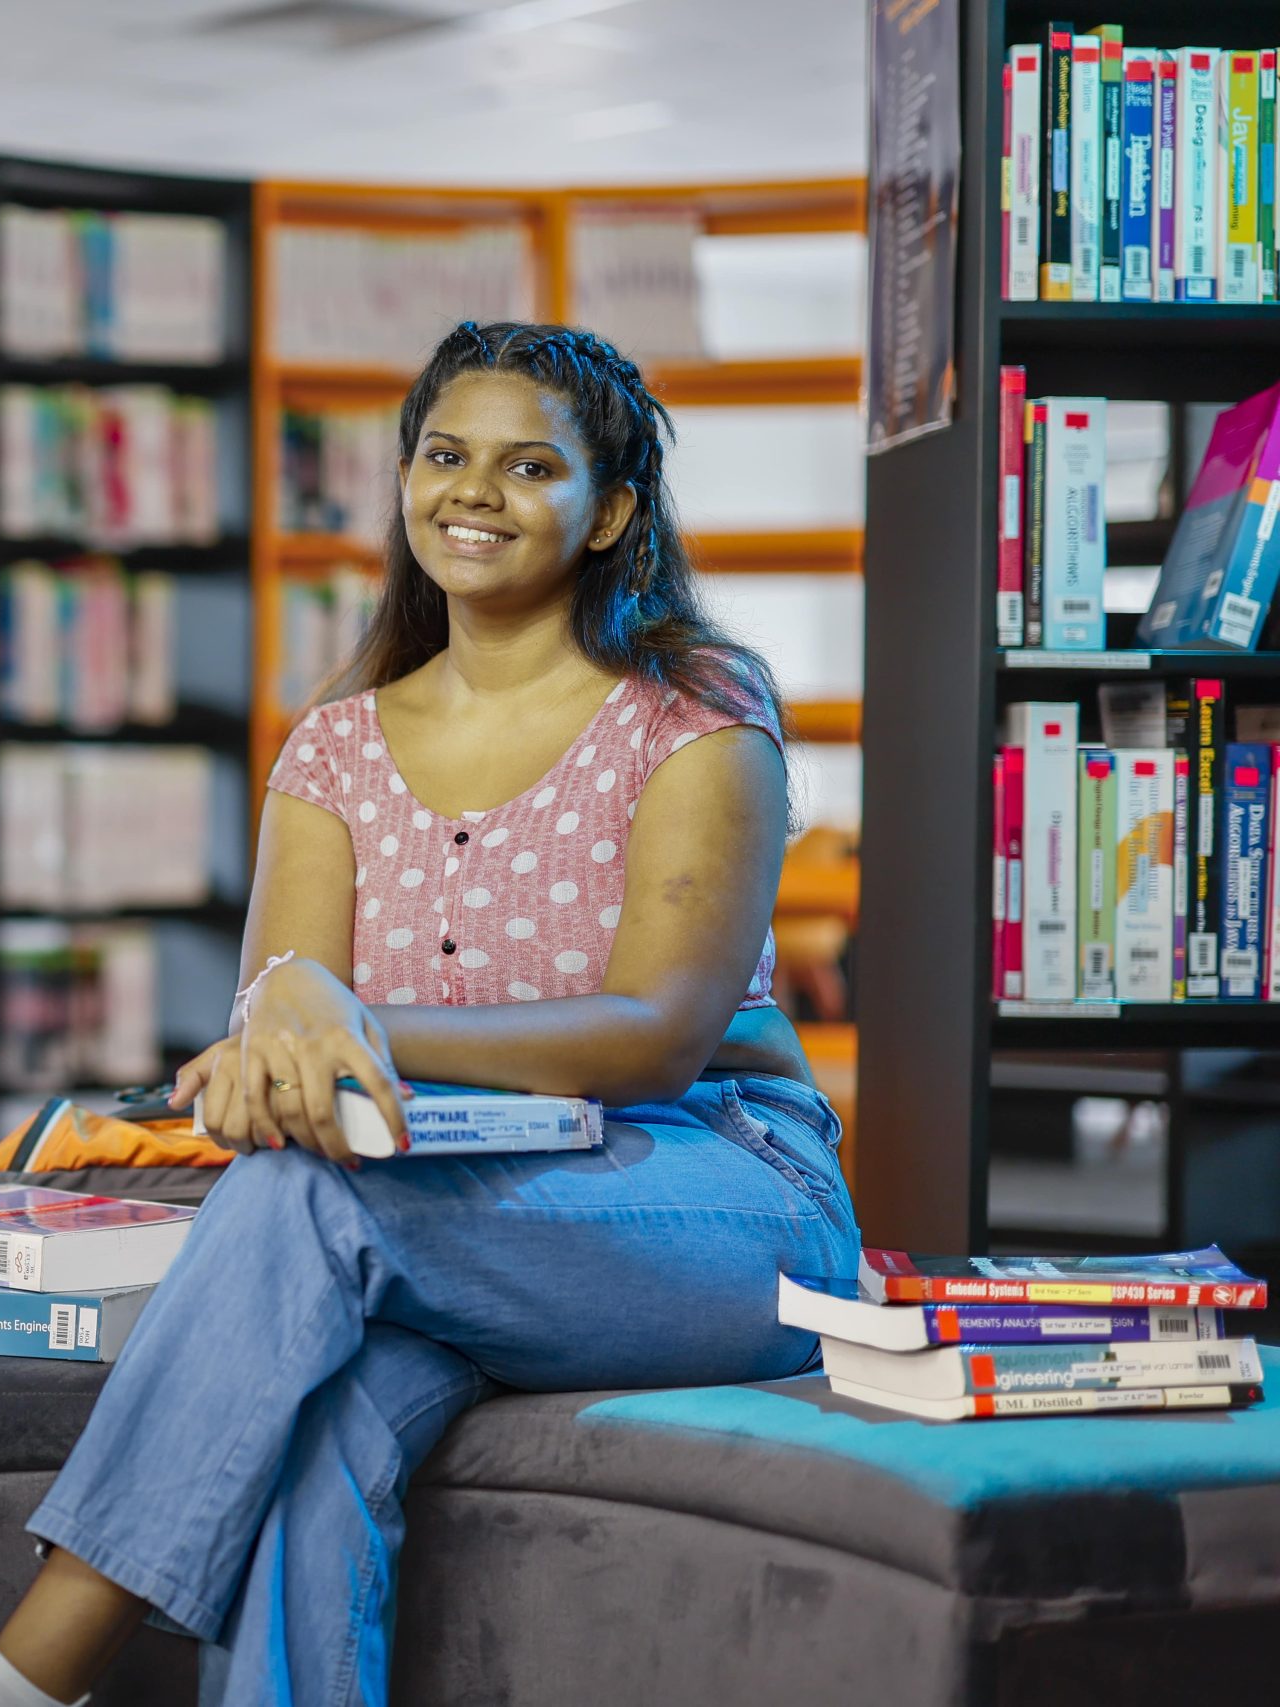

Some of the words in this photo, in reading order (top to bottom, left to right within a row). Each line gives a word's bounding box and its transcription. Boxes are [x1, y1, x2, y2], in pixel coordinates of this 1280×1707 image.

[1162, 90, 1174, 123] Think
[1192, 104, 1207, 146] Desig
[1200, 696, 1216, 746] Learn
[1200, 748, 1216, 796] Excel
[407, 1110, 470, 1125] SOFTWARE
[411, 1129, 488, 1143] ENGINEERIN
[945, 1281, 988, 1297] Embedded
[989, 1282, 1025, 1300] Systems
[1147, 1285, 1176, 1300] Series
[14, 1320, 52, 1334] Enginee
[931, 1317, 1001, 1329] RREMENTS
[1110, 1318, 1135, 1328] SIGN
[995, 1351, 1084, 1367] equirements
[995, 1370, 1075, 1391] ngineering
[1033, 1396, 1084, 1409] Distilled
